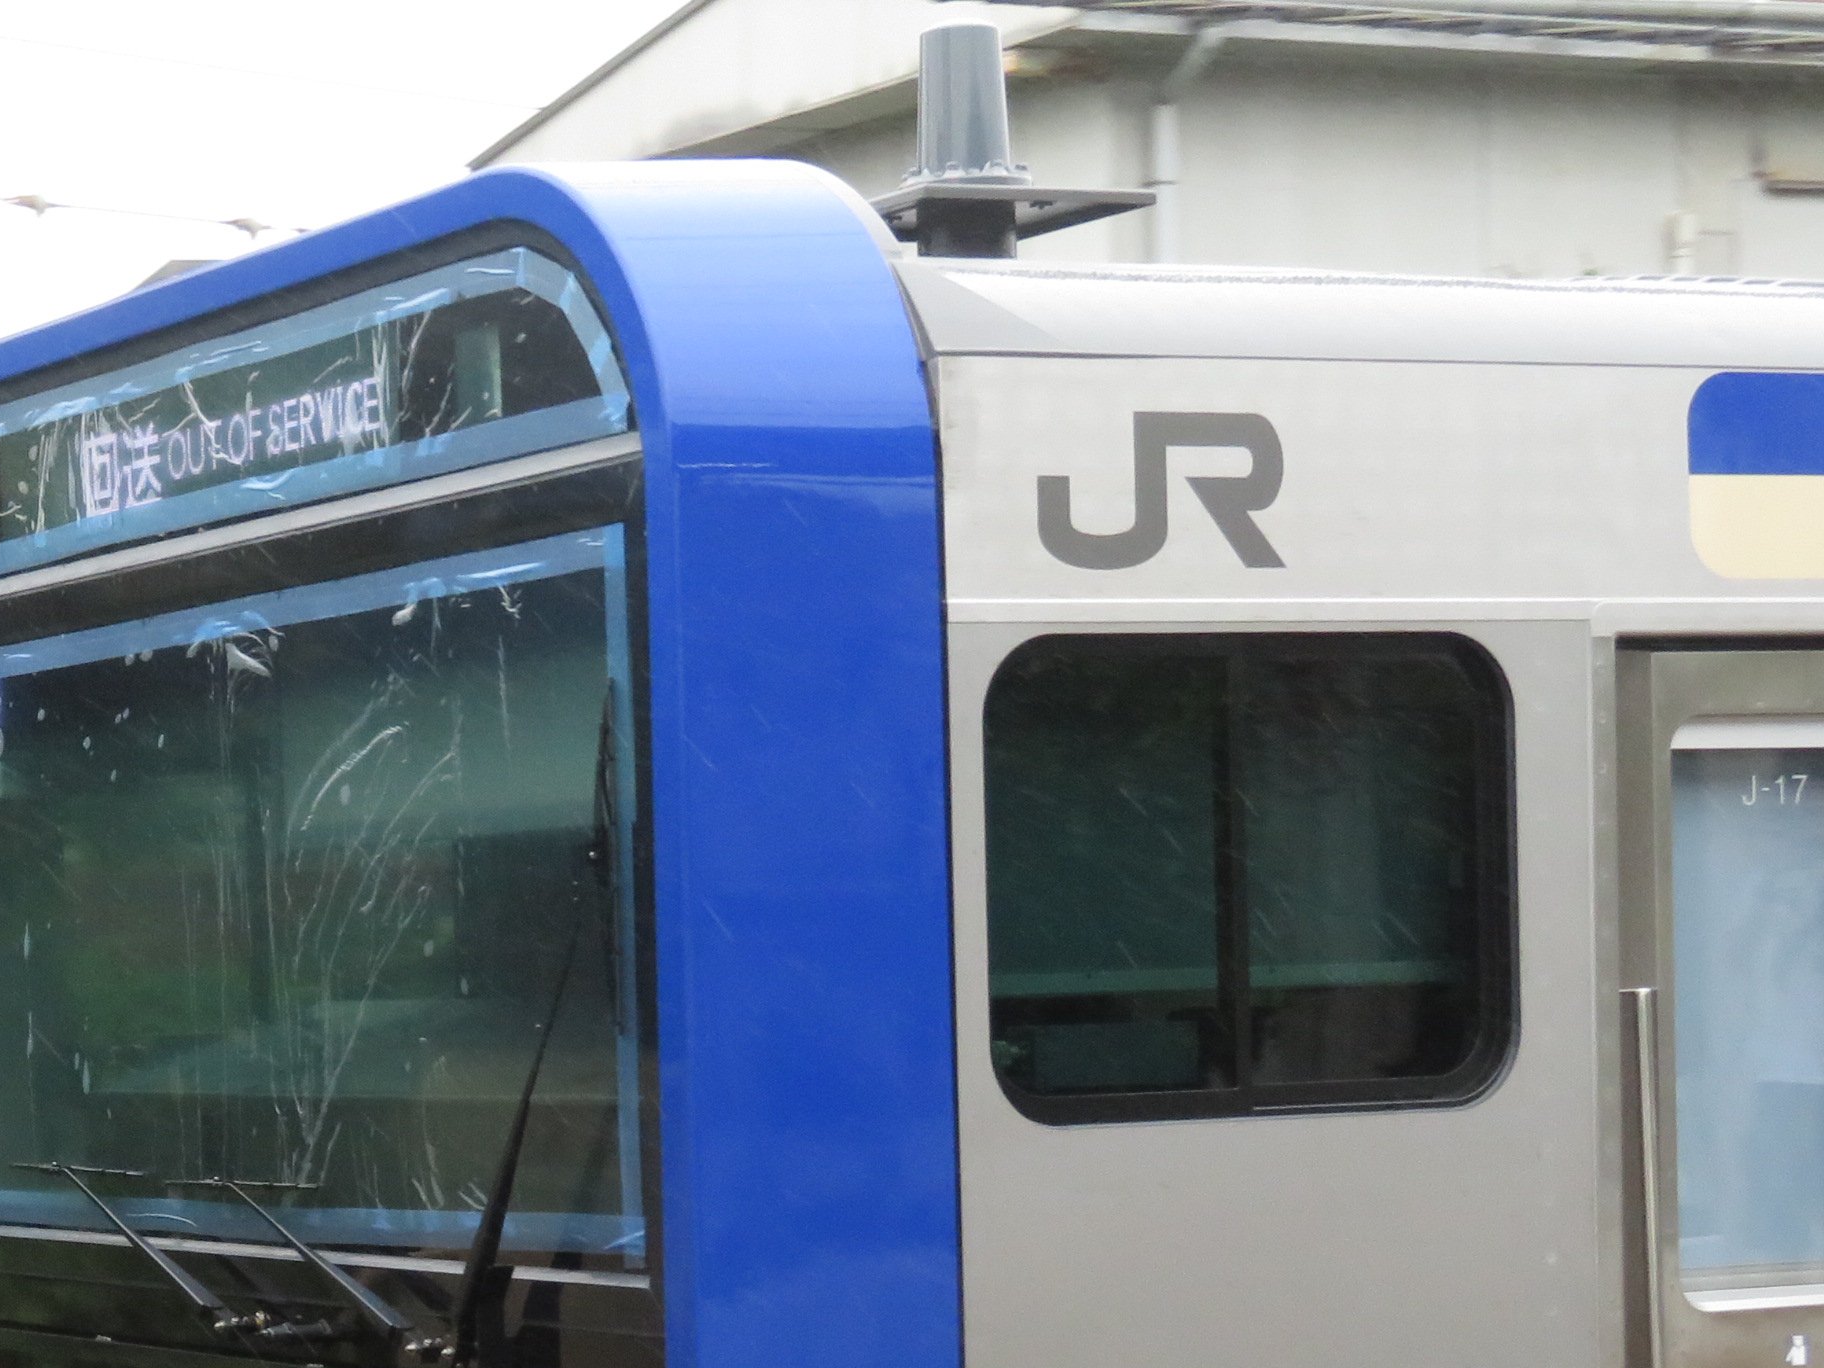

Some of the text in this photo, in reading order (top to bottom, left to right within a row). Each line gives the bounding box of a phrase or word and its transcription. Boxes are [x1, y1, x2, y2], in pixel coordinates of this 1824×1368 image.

[79, 376, 385, 518] 回送 OUT OF SERVICE
[1036, 410, 1288, 571] JR
[1740, 773, 1809, 807] J-17
